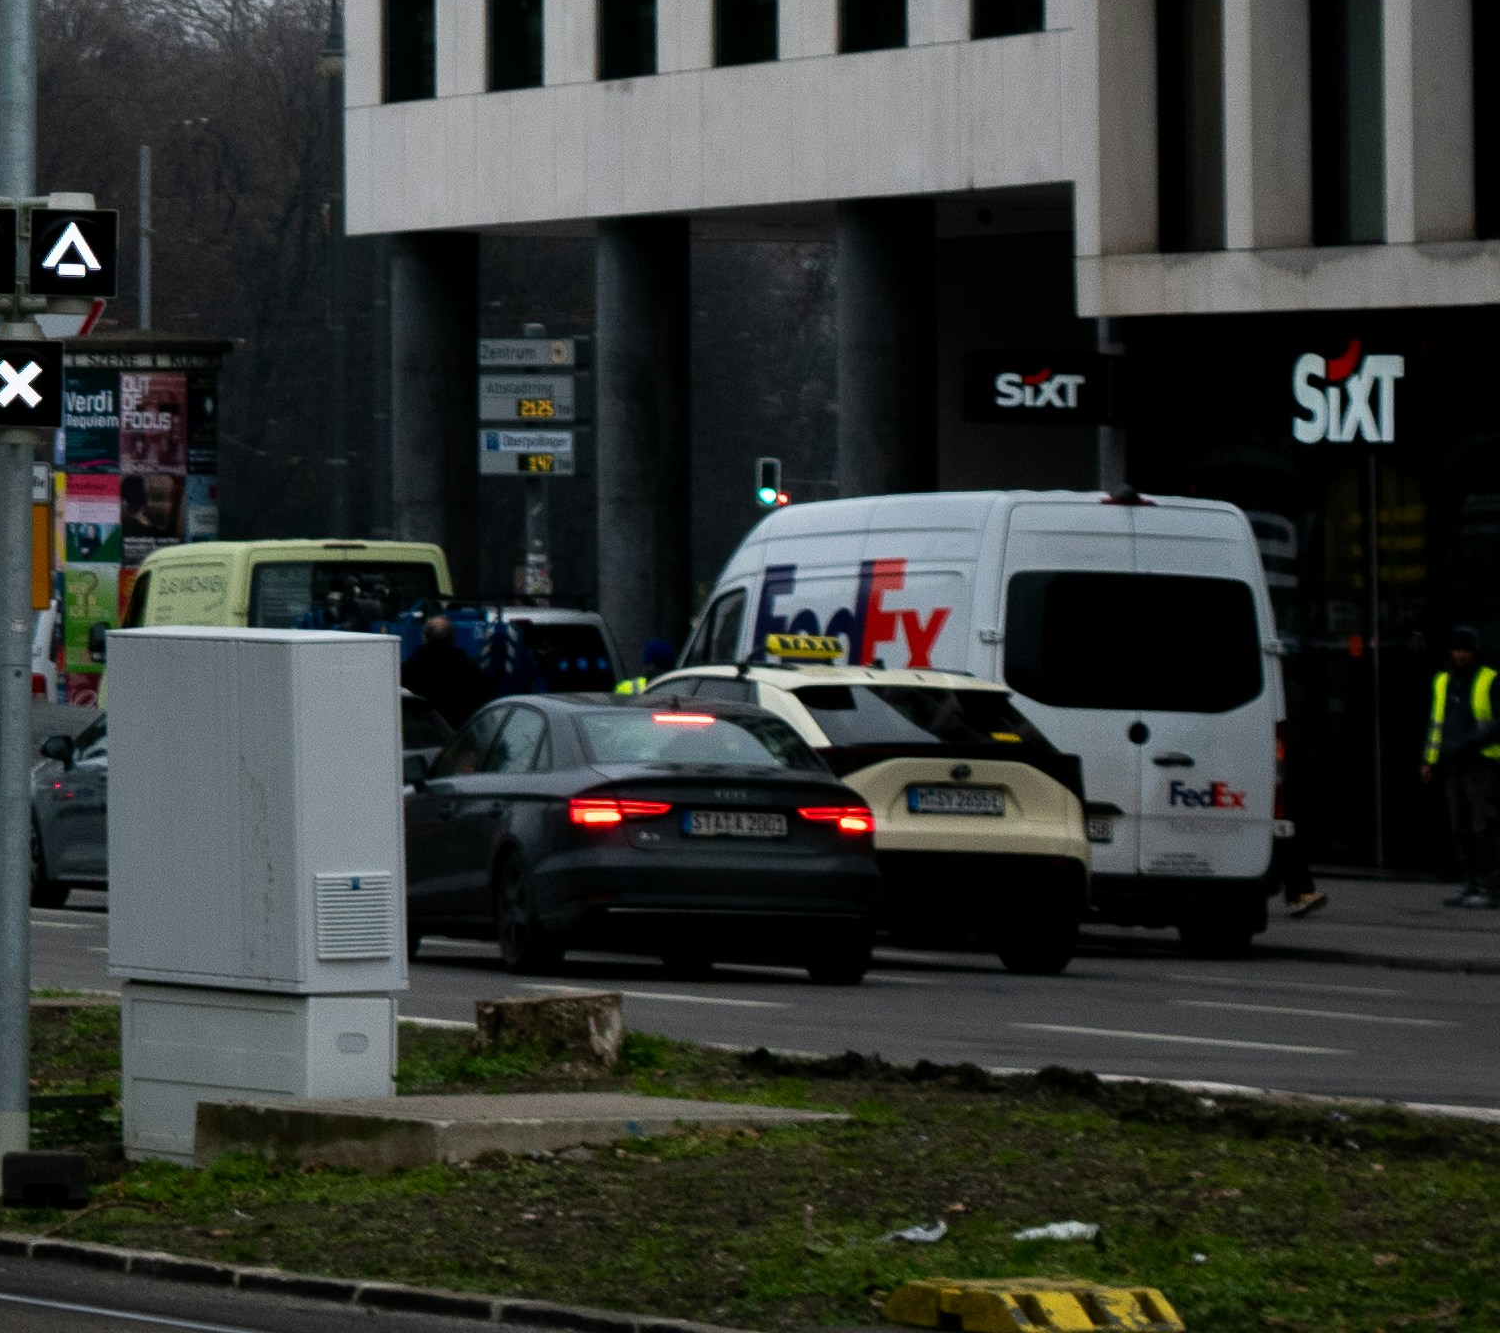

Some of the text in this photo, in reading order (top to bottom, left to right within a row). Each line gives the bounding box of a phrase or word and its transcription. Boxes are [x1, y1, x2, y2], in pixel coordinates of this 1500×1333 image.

[66, 389, 114, 414] Verdi
[66, 413, 119, 431] Requiem
[122, 411, 173, 431] FOCUS
[1169, 780, 1245, 809] FedEx
